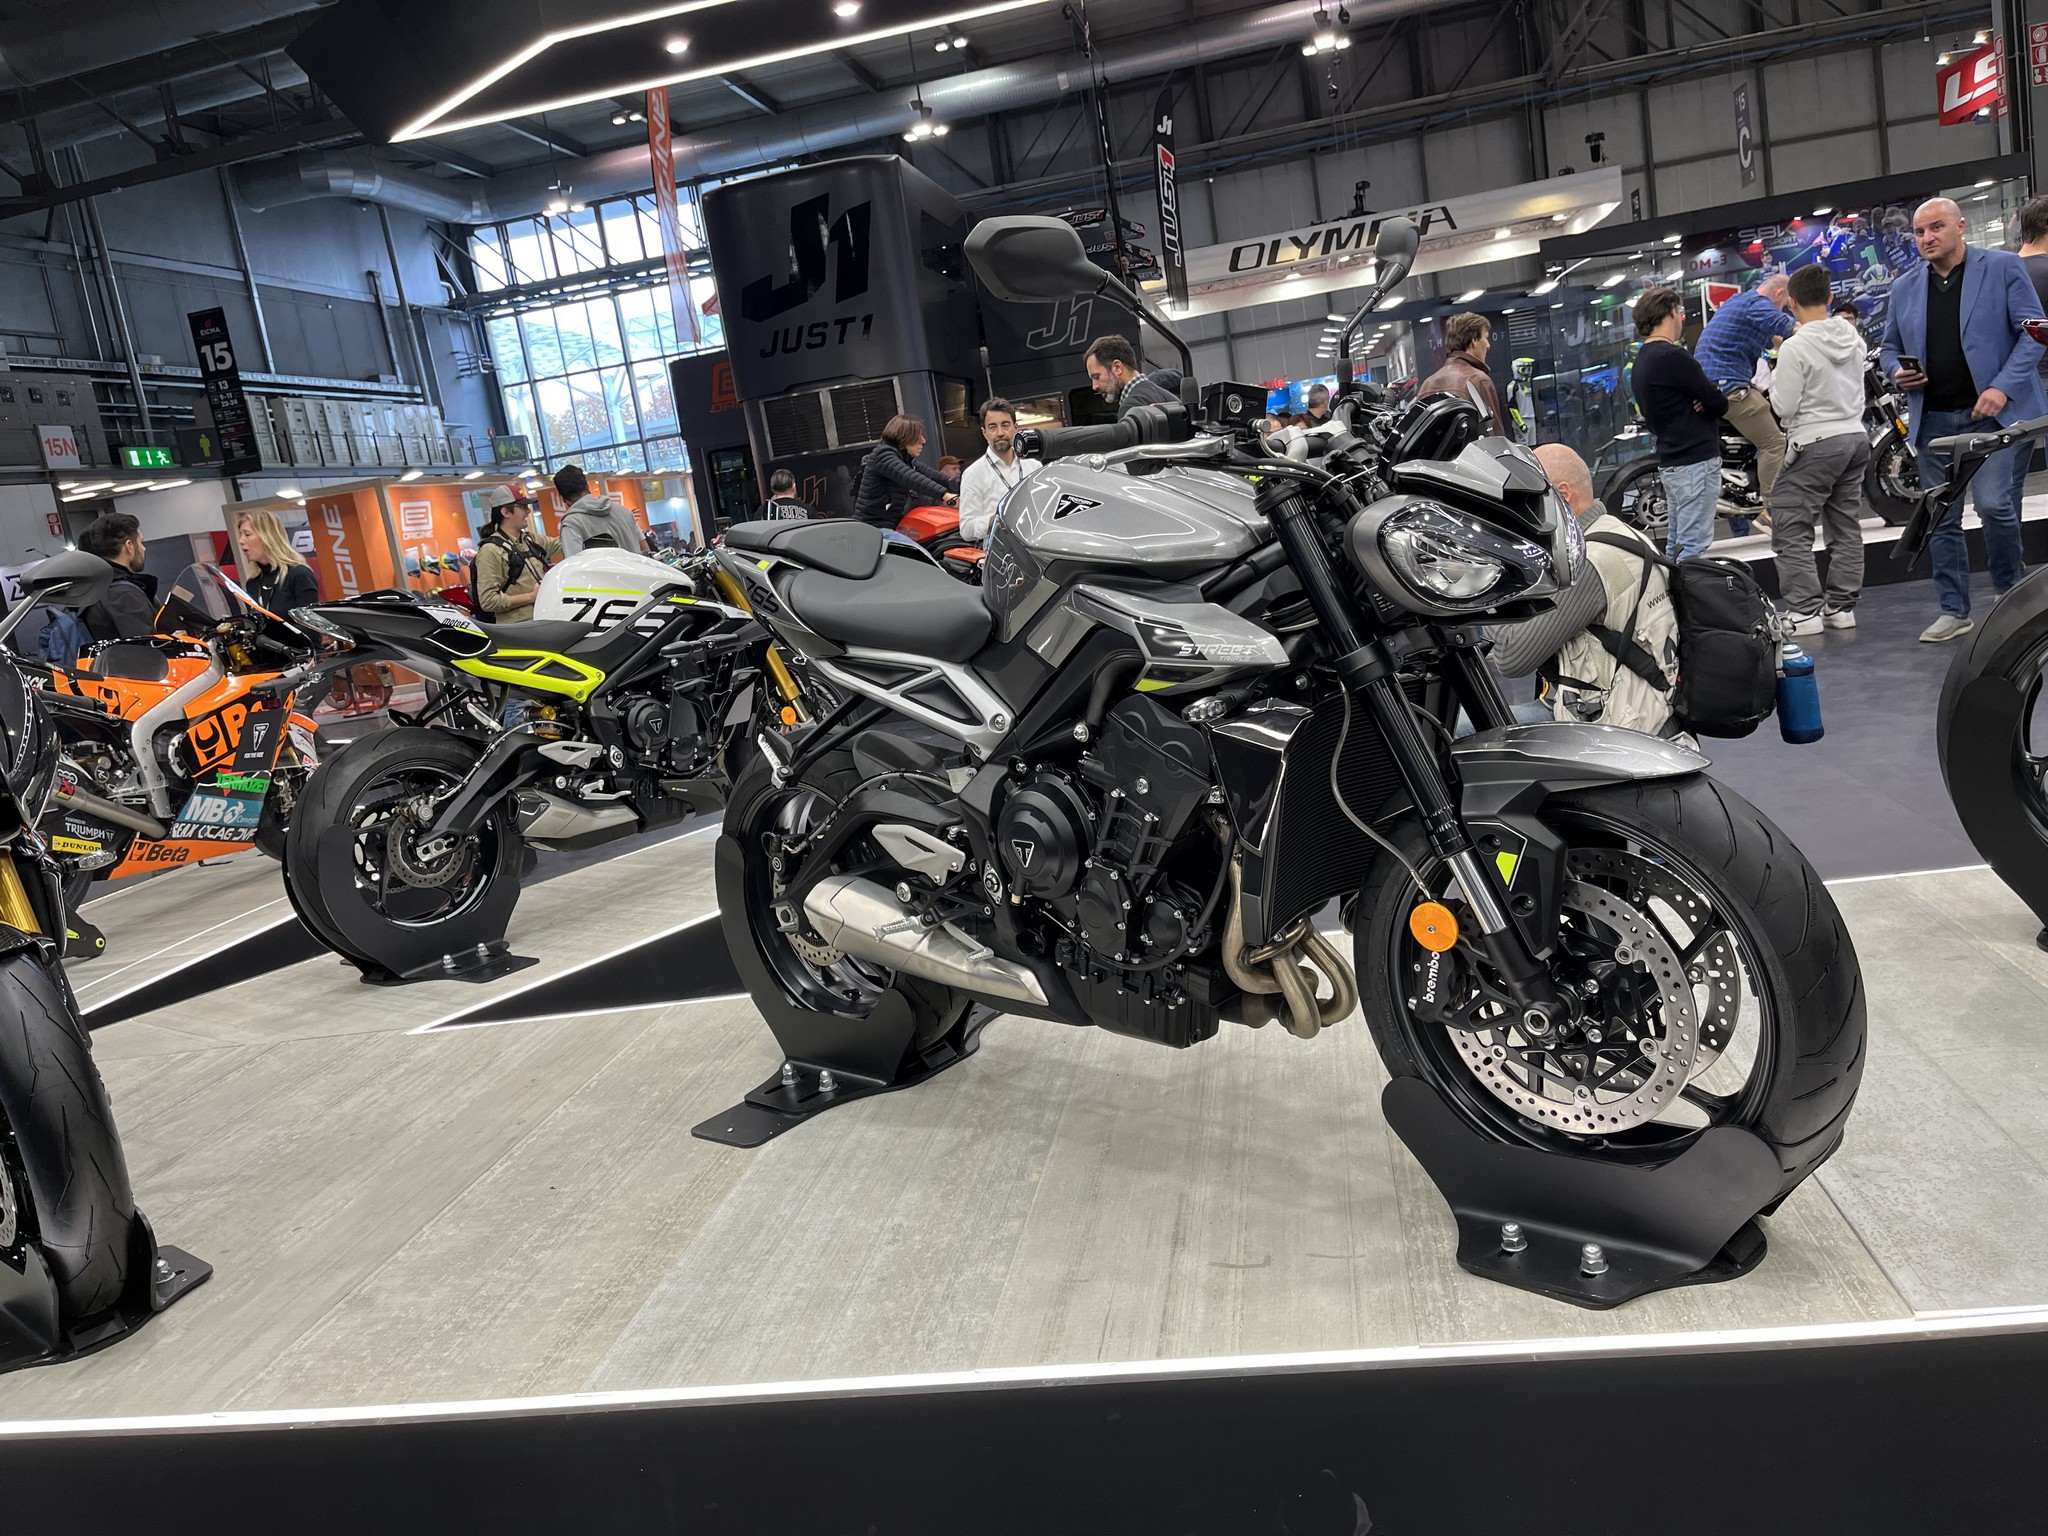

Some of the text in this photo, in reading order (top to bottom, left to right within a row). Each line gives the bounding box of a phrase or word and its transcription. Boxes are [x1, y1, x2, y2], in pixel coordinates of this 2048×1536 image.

[1739, 126, 1752, 169] C
[200, 327, 221, 336] EICMA
[759, 313, 873, 358] JUST1
[200, 341, 233, 372] 15
[217, 380, 229, 391] 13
[44, 437, 77, 457] 15N
[1178, 643, 1257, 656] STREET
[184, 795, 228, 823] MB
[64, 822, 105, 840] TRIUMPH
[146, 844, 190, 862] Beta
[1422, 951, 1440, 1003] brembo
